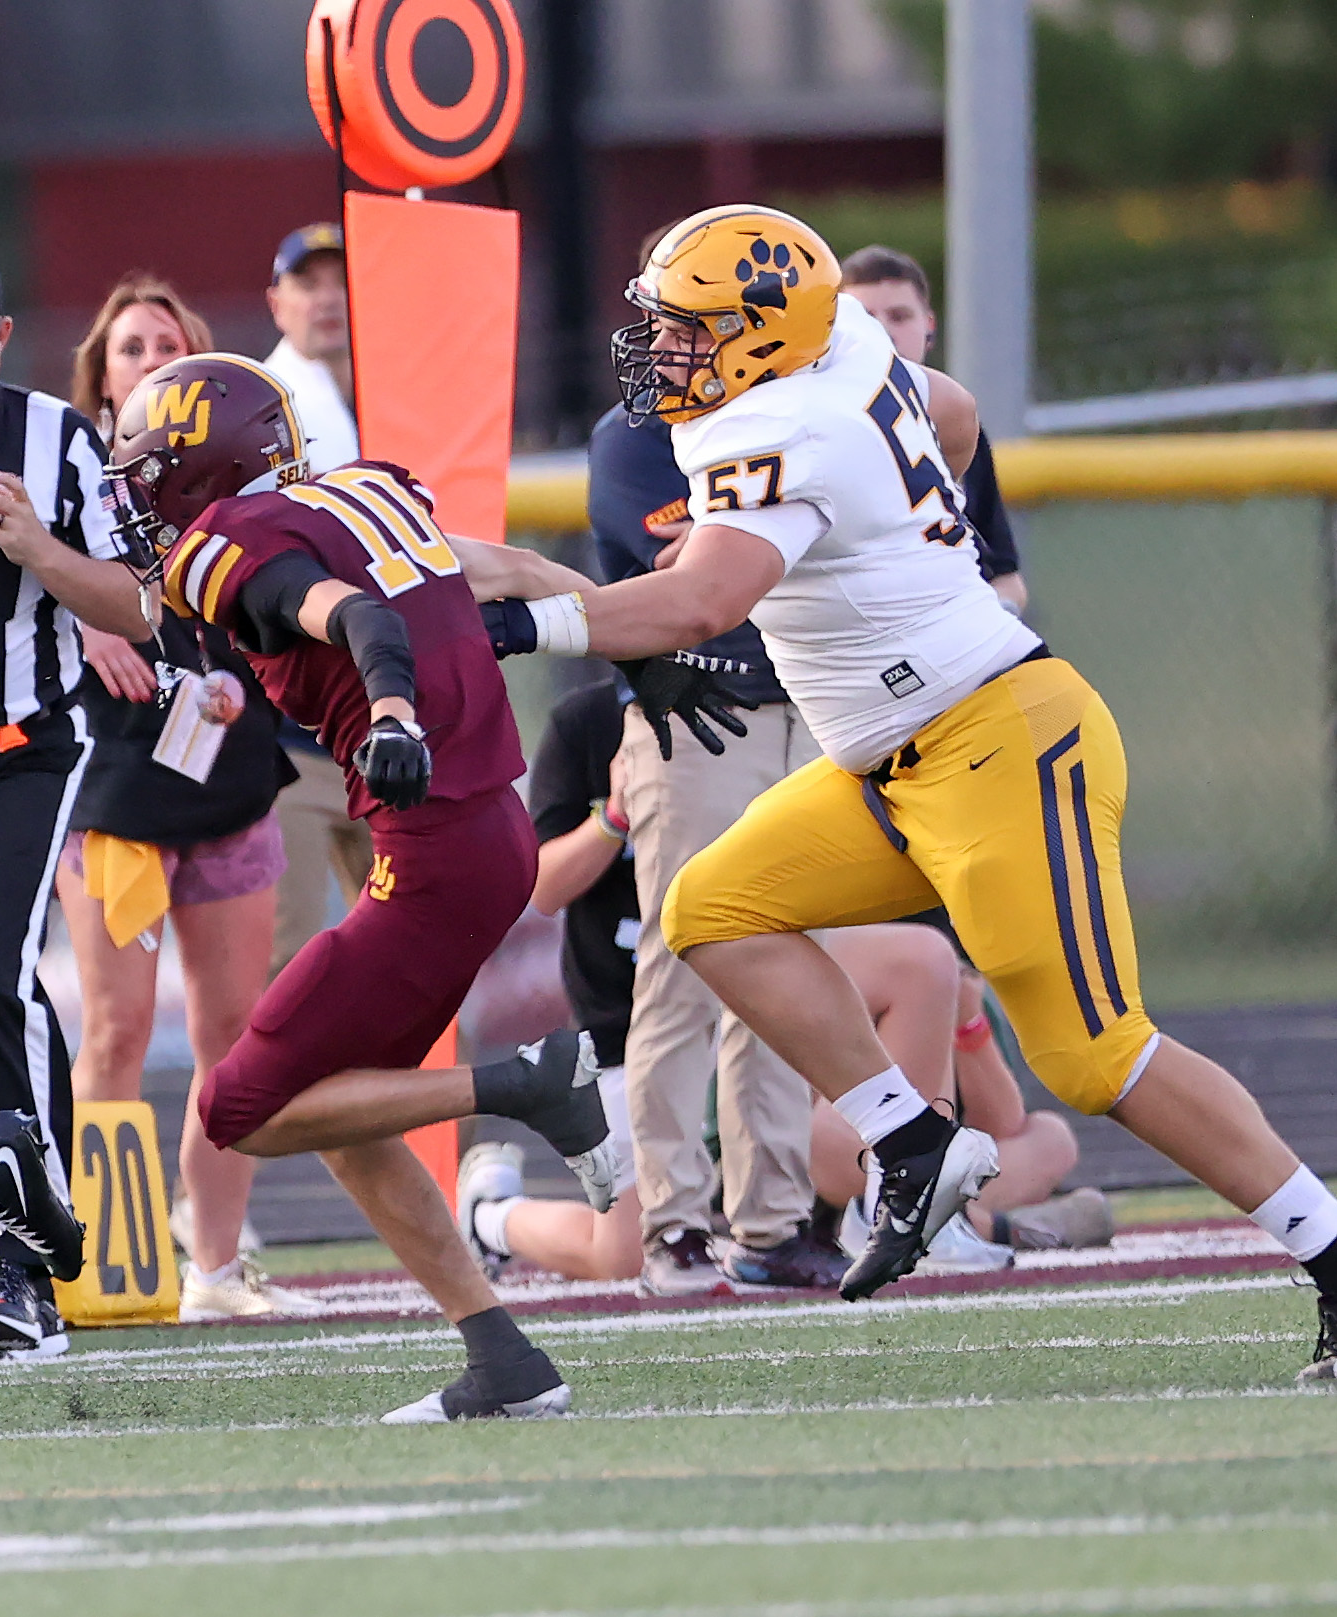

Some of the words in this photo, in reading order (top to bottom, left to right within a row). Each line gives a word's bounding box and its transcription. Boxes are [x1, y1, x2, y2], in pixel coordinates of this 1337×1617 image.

[146, 379, 212, 447] WJ
[706, 451, 783, 513] 57
[278, 467, 462, 599] 10
[884, 666, 910, 684] 2XL
[82, 1122, 159, 1296] 20
